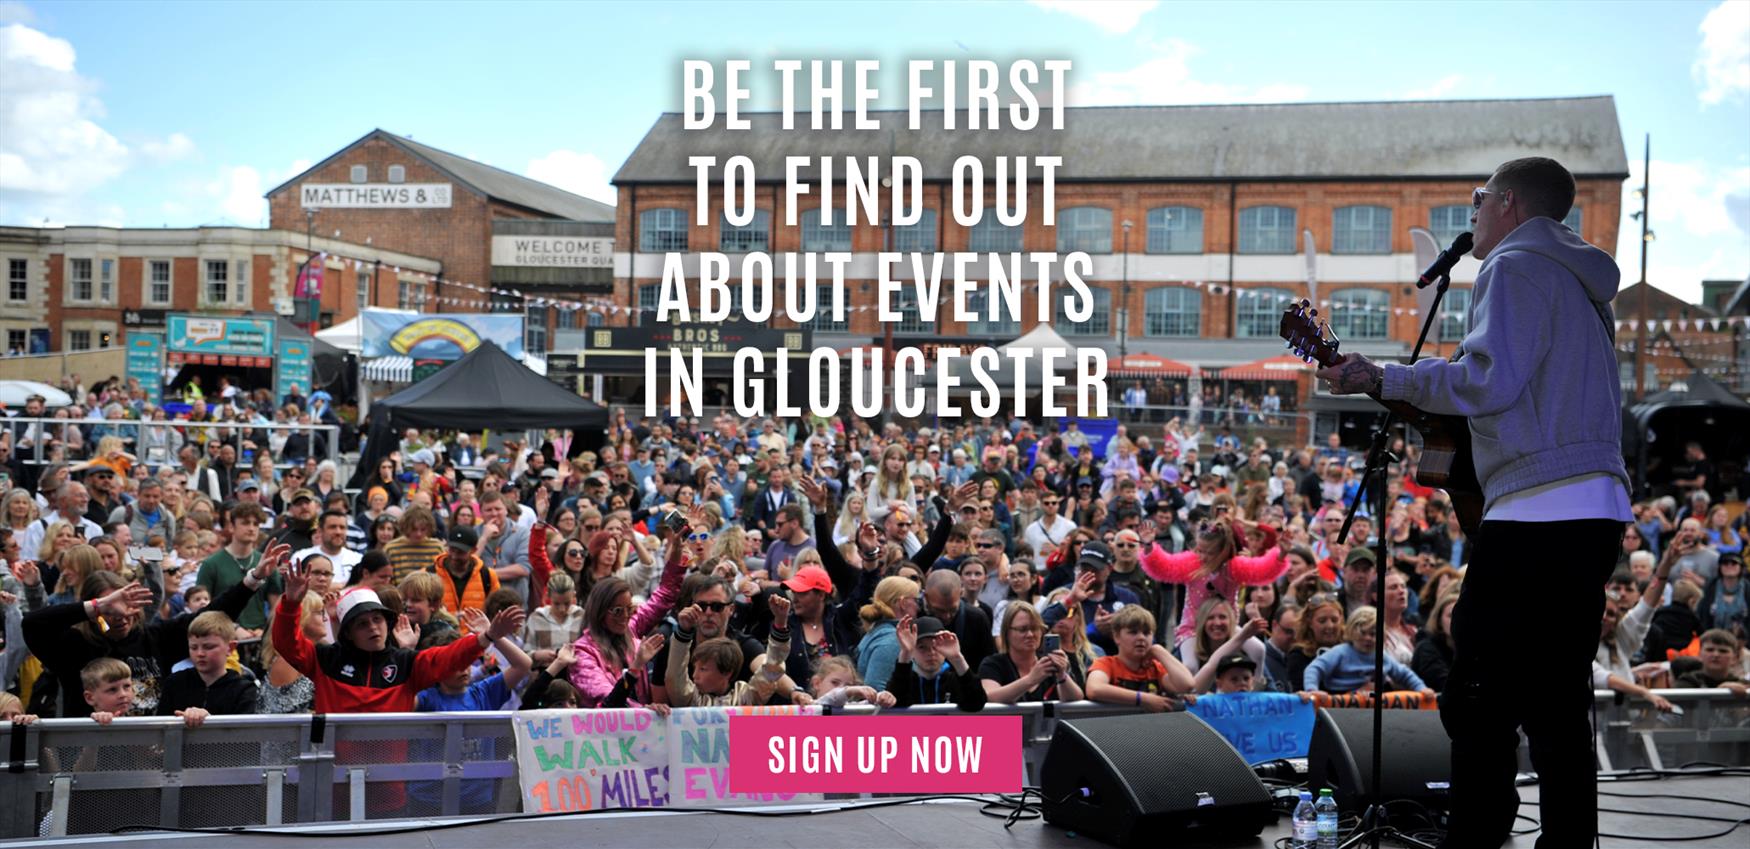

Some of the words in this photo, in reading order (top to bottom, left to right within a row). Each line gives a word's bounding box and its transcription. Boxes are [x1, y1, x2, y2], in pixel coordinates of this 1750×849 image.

[304, 188, 409, 204] MATTHEWS
[416, 188, 427, 203] &
[515, 240, 602, 254] WELCOME
[515, 255, 588, 266] GLOUCESTER
[592, 257, 615, 266] QUA
[673, 328, 720, 342] BROS
[1203, 696, 1295, 718] NATHAN
[526, 717, 562, 740] WE
[571, 710, 652, 735] WOULD
[1267, 732, 1297, 753] US
[533, 736, 638, 772] WALK
[531, 774, 592, 812] 100
